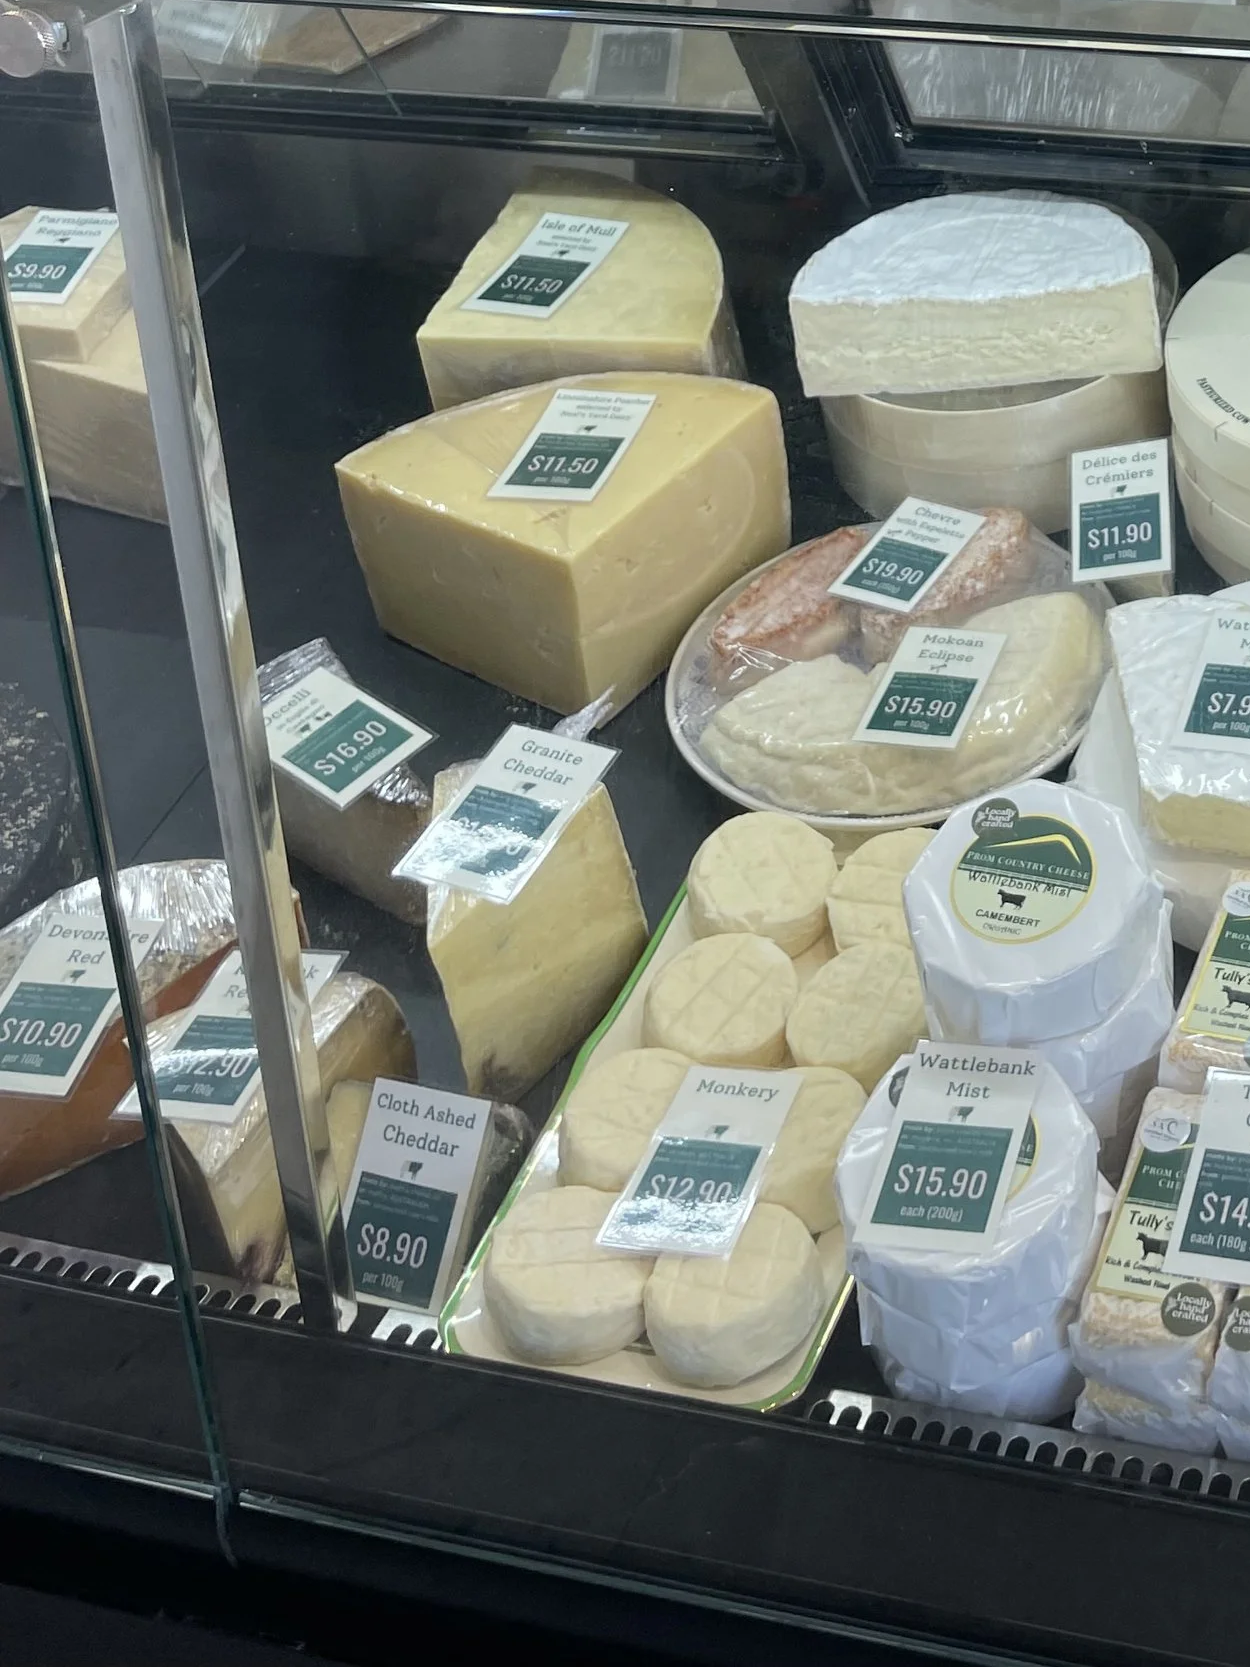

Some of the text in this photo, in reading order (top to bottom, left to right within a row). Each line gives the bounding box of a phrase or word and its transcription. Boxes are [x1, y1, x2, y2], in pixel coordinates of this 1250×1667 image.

[541, 219, 586, 233] Isle of
[8, 262, 67, 280] $9.90
[501, 274, 564, 294] $11.50
[528, 455, 599, 474] $11.50
[1082, 451, 1157, 470] Délice des
[1085, 468, 1154, 485] Crémiers
[1088, 522, 1152, 548] $11.90
[863, 558, 924, 584] $19.90
[923, 634, 984, 648] Mokoan
[918, 649, 975, 663] Eclipse
[885, 696, 956, 718] $15.90
[314, 720, 387, 776] $16.90
[521, 740, 583, 765] Granite
[503, 758, 573, 786] Cheddar
[985, 807, 1017, 817] Locally
[966, 851, 1090, 880] PROM COUNTRY CHEESE
[975, 909, 1040, 927] CAMEMBERT
[67, 949, 106, 965] Red
[0, 1018, 82, 1048] $10.90
[920, 1053, 1036, 1076] Wattlebank
[696, 1079, 779, 1102] Monkery
[946, 1081, 990, 1099] Mist
[377, 1093, 476, 1129] Cloth Ashed
[383, 1124, 460, 1157] Cheddar
[1142, 1165, 1174, 1178] PROM
[894, 1164, 988, 1200] $15.90
[900, 1206, 963, 1223] each (200g)
[1129, 1211, 1174, 1231] Tully's
[357, 1222, 428, 1269] $8.90
[1190, 1233, 1214, 1247] each
[1216, 1234, 1247, 1253] (180g
[1177, 1293, 1212, 1308] Locally
[1172, 1309, 1209, 1323] crafted
